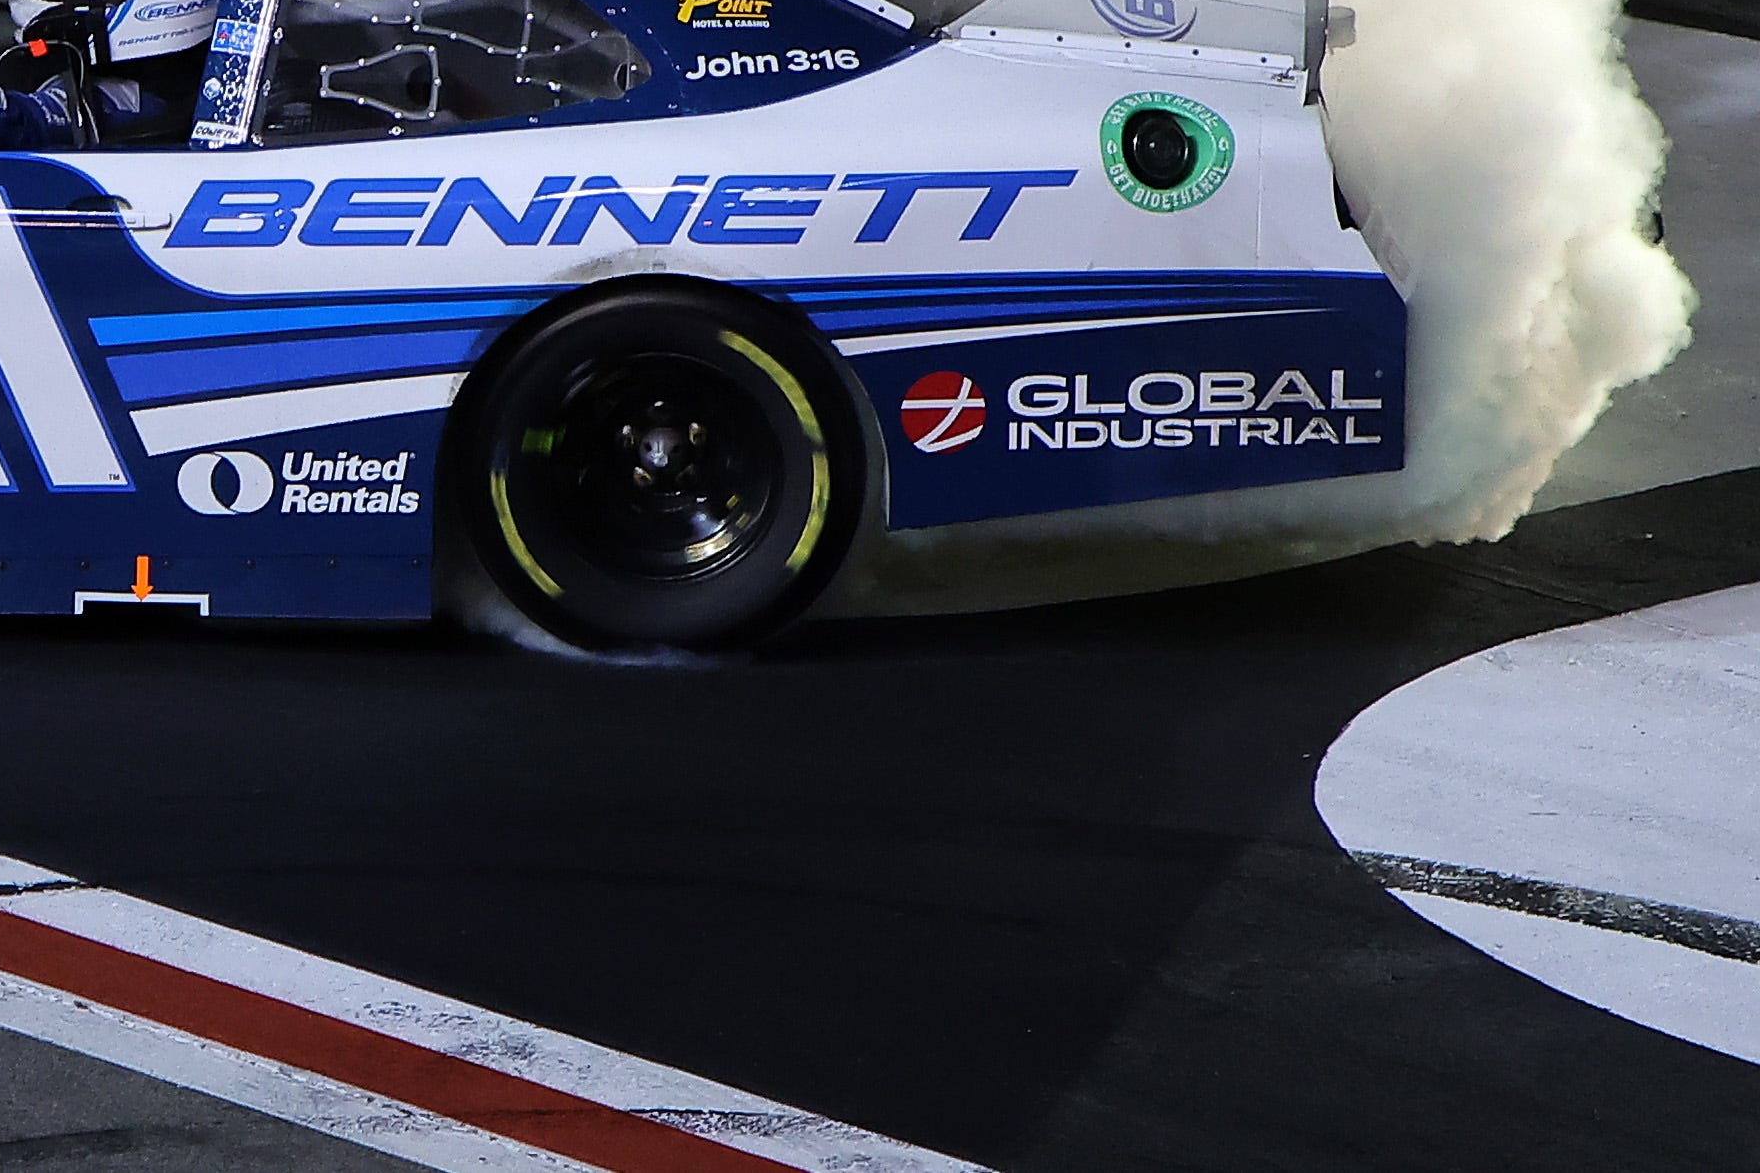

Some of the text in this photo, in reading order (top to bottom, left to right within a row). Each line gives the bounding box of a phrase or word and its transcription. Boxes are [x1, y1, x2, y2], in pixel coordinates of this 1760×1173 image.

[685, 49, 861, 81] John 3:16
[163, 169, 1078, 248] BENNETT
[1007, 369, 1382, 417] GLOBAL
[1008, 416, 1381, 451] INDUSTRIAL
[282, 452, 408, 482] United
[281, 484, 420, 513] Rentals
